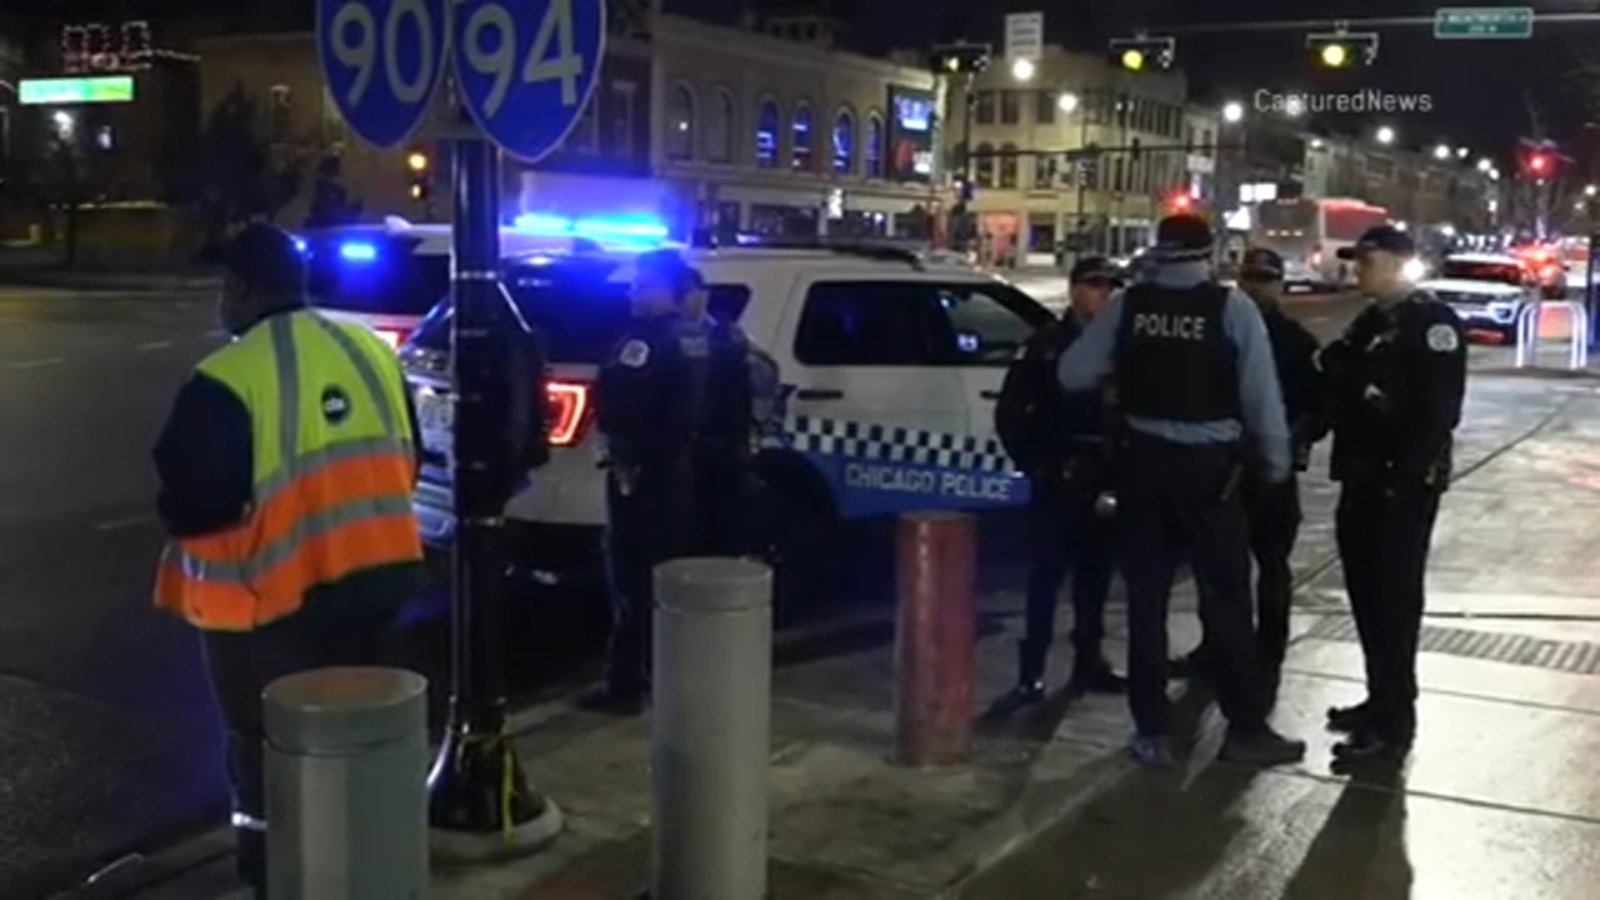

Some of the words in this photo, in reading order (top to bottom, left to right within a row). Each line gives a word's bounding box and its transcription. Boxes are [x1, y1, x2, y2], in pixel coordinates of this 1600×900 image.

[331, 0, 433, 107] 90
[464, 0, 583, 118] 94
[1134, 313, 1206, 339] POLICE
[845, 462, 935, 494] CHICAGO
[940, 472, 1011, 500] POLICE
